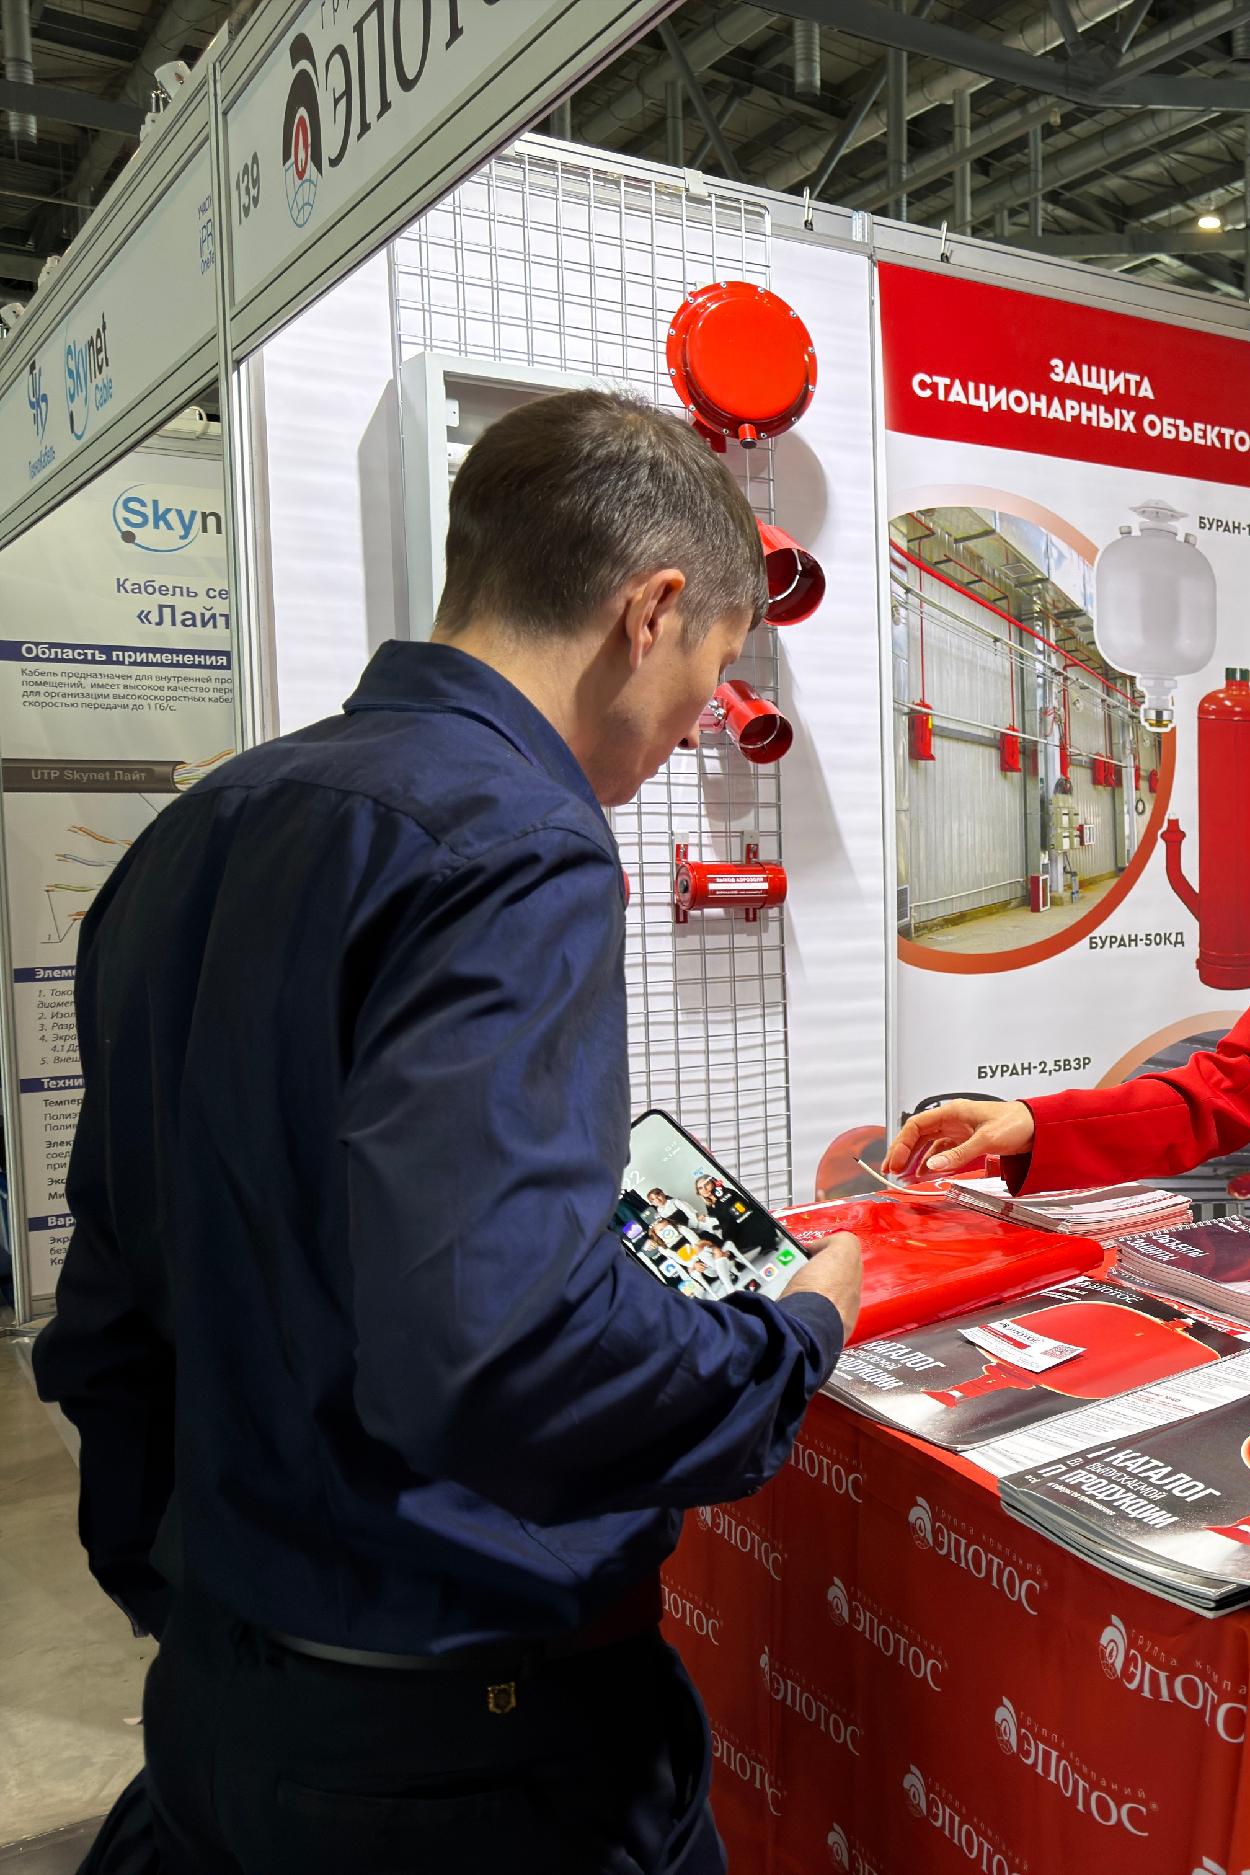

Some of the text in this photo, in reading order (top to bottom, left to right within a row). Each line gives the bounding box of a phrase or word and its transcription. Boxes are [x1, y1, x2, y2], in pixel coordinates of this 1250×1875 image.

[325, 0, 503, 168] ЭПО
[235, 152, 260, 226] 139
[66, 312, 109, 403] Skynet
[1049, 358, 1155, 400] ЗАЩИТА
[911, 373, 1137, 434] СТАЦИОНАРНЫХ
[122, 496, 222, 540] Skyn
[116, 578, 230, 600] Кабель се
[136, 603, 231, 630] «Лайт
[21, 643, 228, 667] Область применения
[21, 668, 234, 687] Кабель предназначен для внутренней про
[22, 690, 41, 699] для
[43, 691, 110, 702] организации
[112, 693, 206, 704] высокоскоростных
[90, 682, 121, 690] имеет
[122, 683, 165, 692] высокое
[166, 685, 209, 694] качество
[22, 699, 79, 709] скоростью
[81, 702, 129, 713] передачи
[131, 703, 145, 712] до
[31, 768, 110, 783] UTP Skynet
[1088, 931, 1185, 950] БУРАН-50КД
[34, 968, 76, 979] Элем
[50, 988, 74, 997] Токо
[50, 1011, 76, 1020] Изол
[51, 1022, 75, 1032] Разр
[51, 1033, 77, 1043] Экра
[53, 1055, 80, 1065] Внеш
[41, 1078, 83, 1089] Техни
[43, 1098, 84, 1108] Темпер
[44, 1112, 80, 1121] Полиэ
[45, 1140, 72, 1149] Элек
[47, 1177, 67, 1186] Экс
[48, 1192, 65, 1200] Ми
[47, 1216, 75, 1227] Вар
[49, 1236, 70, 1245] Экр
[859, 1340, 946, 1371] КАТАЛОГ
[789, 1441, 863, 1503] ПОТОС
[1086, 1463, 1168, 1501] ВЫПУСКАЕМОЙ
[1104, 1450, 1221, 1502] КАТАЛОГ
[1059, 1469, 1180, 1528] ПРОДУКЦИИ
[934, 1523, 1041, 1615] ЭПОТОС
[852, 1601, 942, 1692] ЭПОТОС
[1195, 1659, 1248, 1695] компа
[771, 1671, 861, 1757] ЭПОТОС
[1020, 1728, 1149, 1837] ЭПОТОС
[928, 1793, 1023, 1875] ЭПОТО
